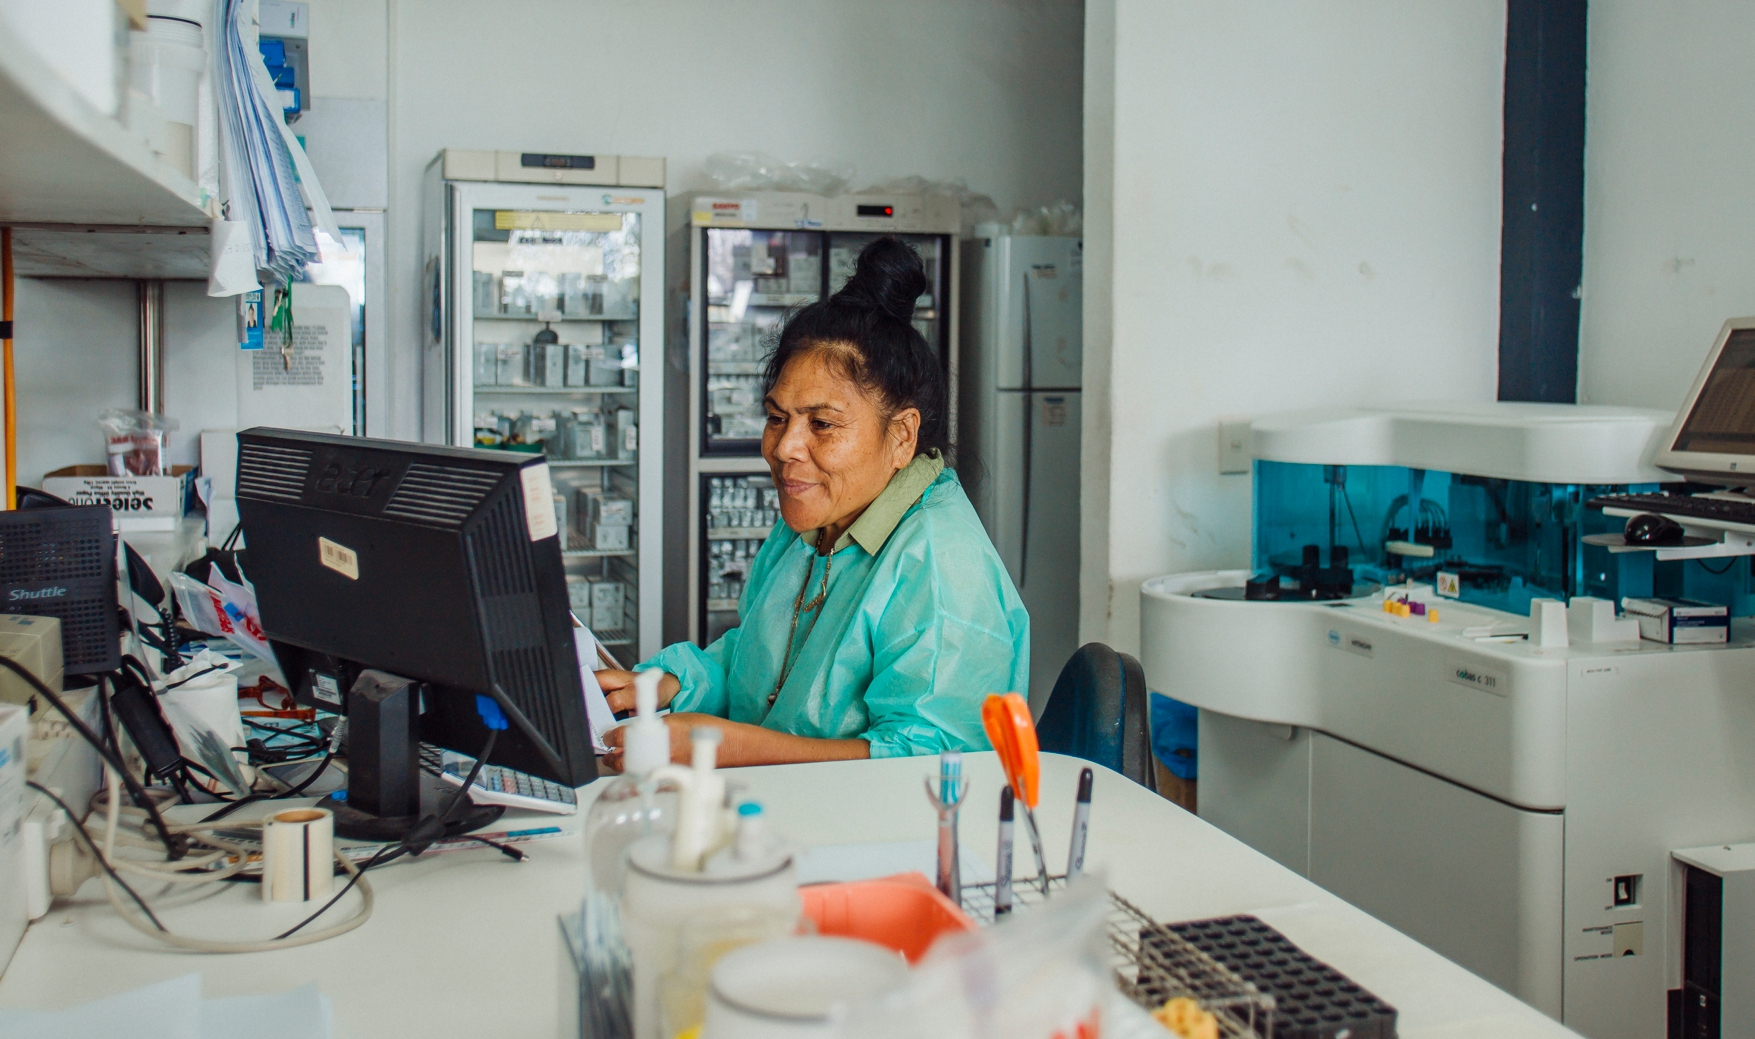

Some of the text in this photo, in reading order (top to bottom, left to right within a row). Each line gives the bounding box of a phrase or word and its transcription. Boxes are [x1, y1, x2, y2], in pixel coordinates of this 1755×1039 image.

[316, 463, 391, 499] acer
[9, 586, 67, 601] Shuttle
[1455, 669, 1476, 682] cobas
[1484, 675, 1496, 687] 311
